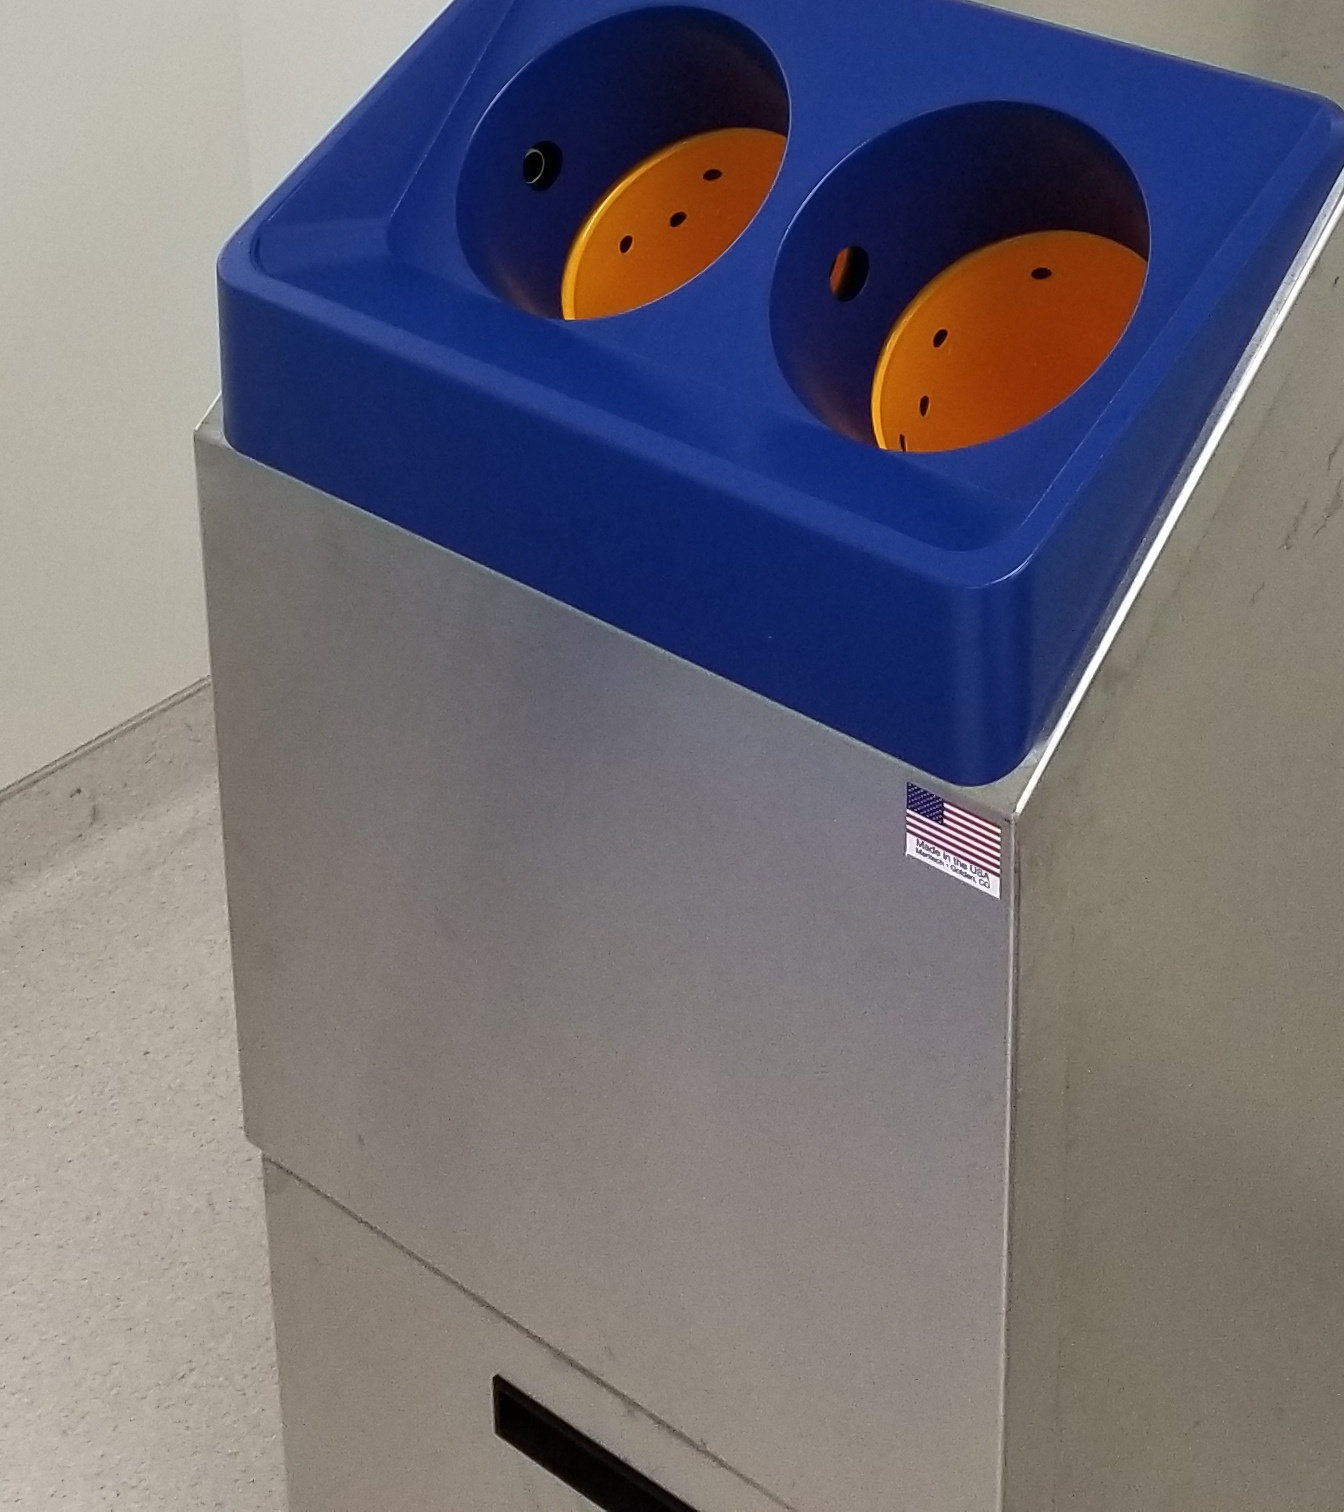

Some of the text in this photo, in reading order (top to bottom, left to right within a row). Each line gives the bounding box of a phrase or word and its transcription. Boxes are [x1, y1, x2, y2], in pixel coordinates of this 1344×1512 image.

[916, 837, 990, 881] Made in the USA
[978, 878, 991, 889] CO
